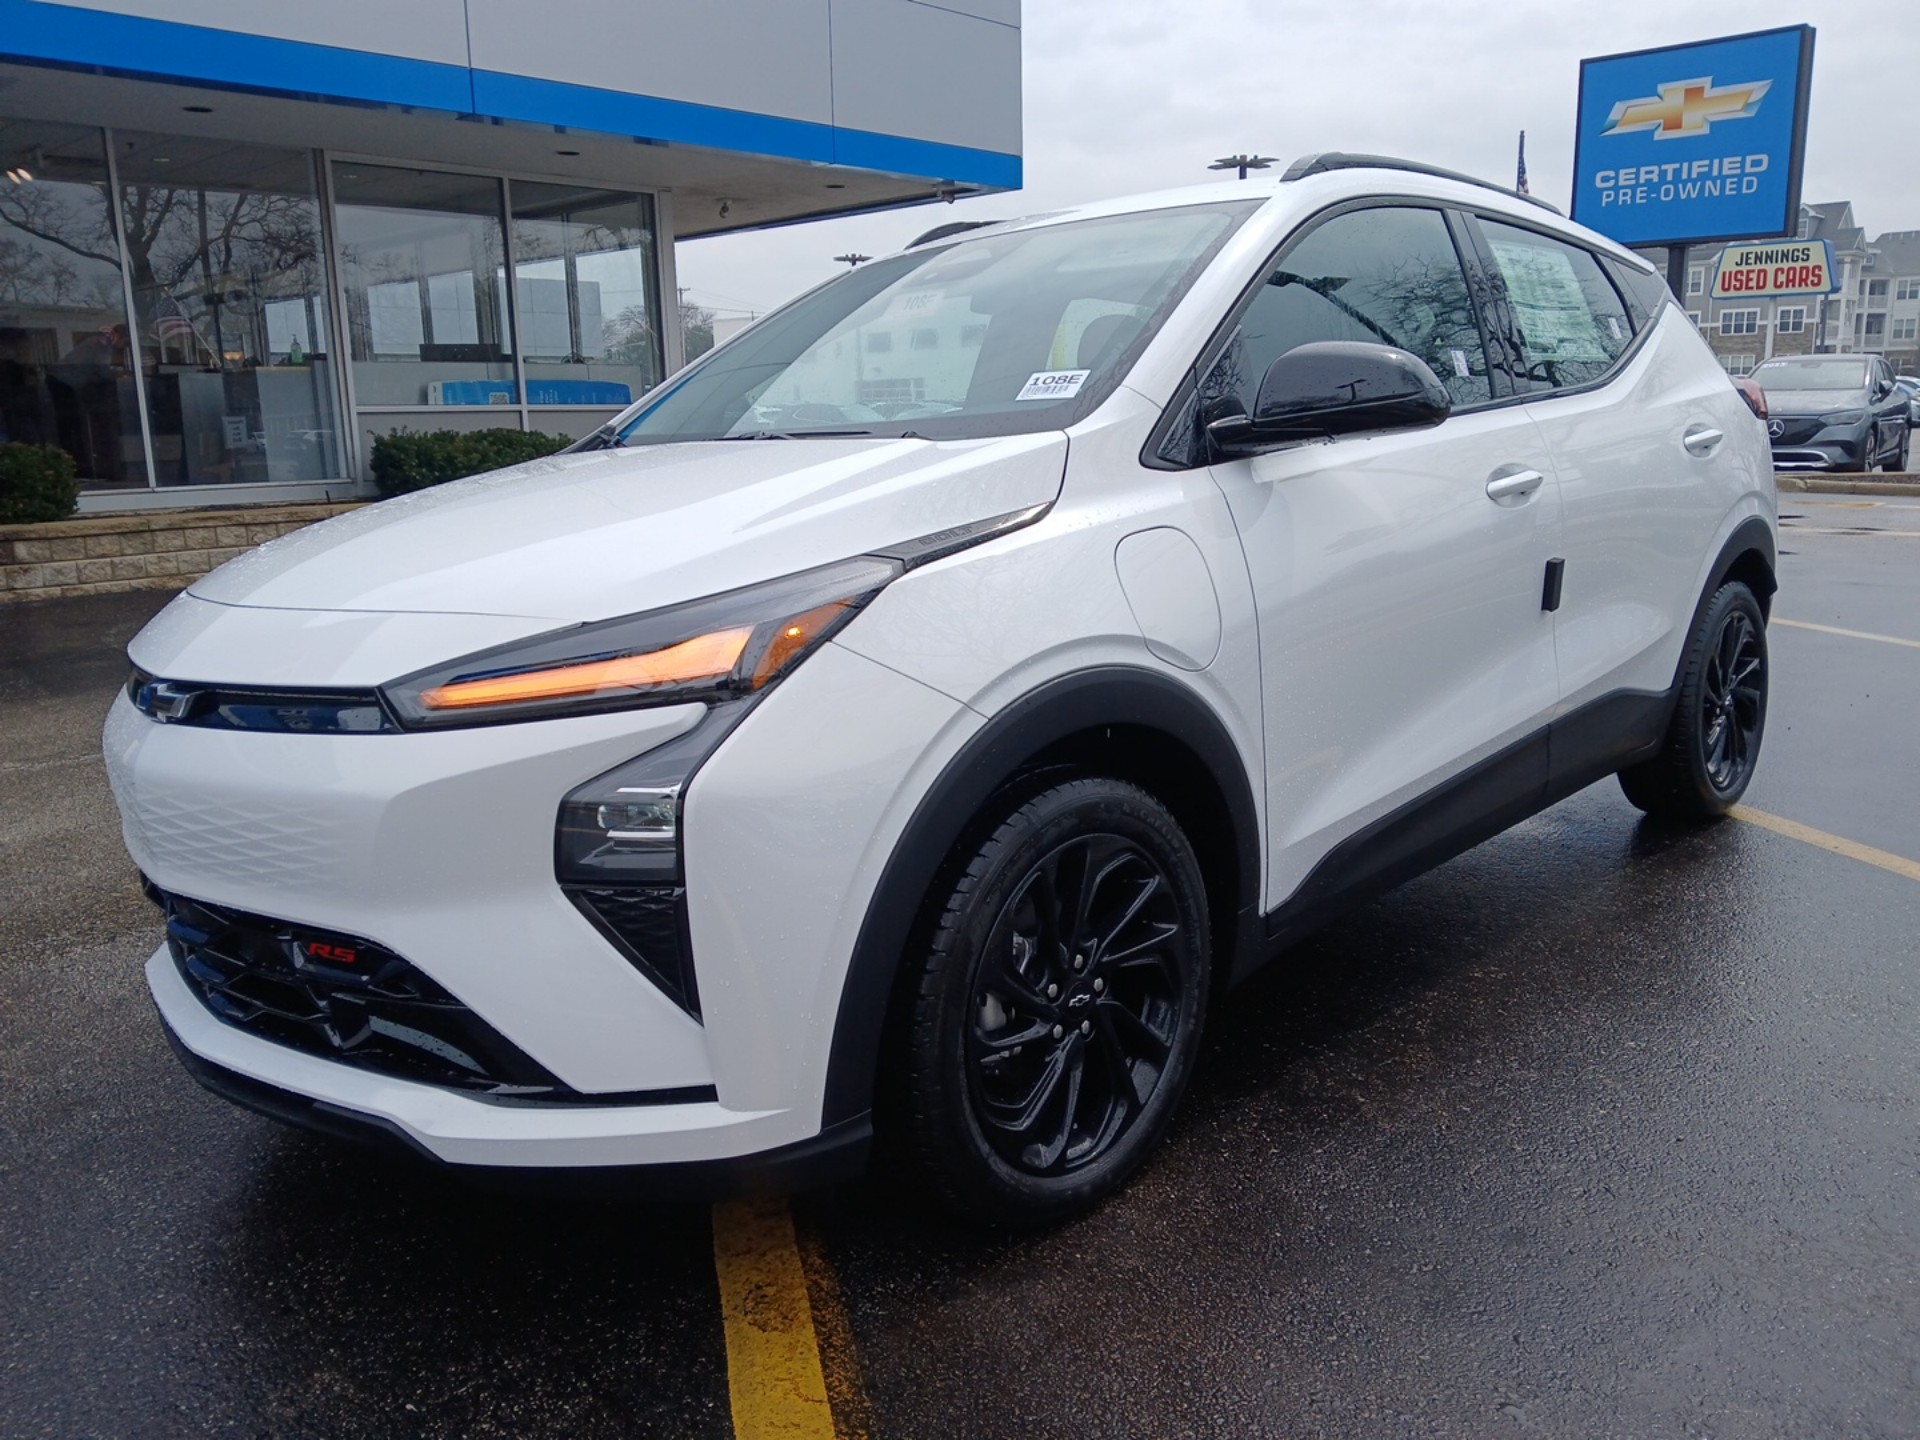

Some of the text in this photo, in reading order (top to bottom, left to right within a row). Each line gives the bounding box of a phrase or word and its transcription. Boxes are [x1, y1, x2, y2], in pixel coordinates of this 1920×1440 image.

[1595, 153, 1769, 189] CERTIFIED
[1601, 176, 1758, 207] PRE-OWNED
[1735, 247, 1811, 266] JENNINGS
[1721, 265, 1823, 293] USED CARS
[1029, 374, 1084, 386] 108E
[308, 943, 356, 963] RS
